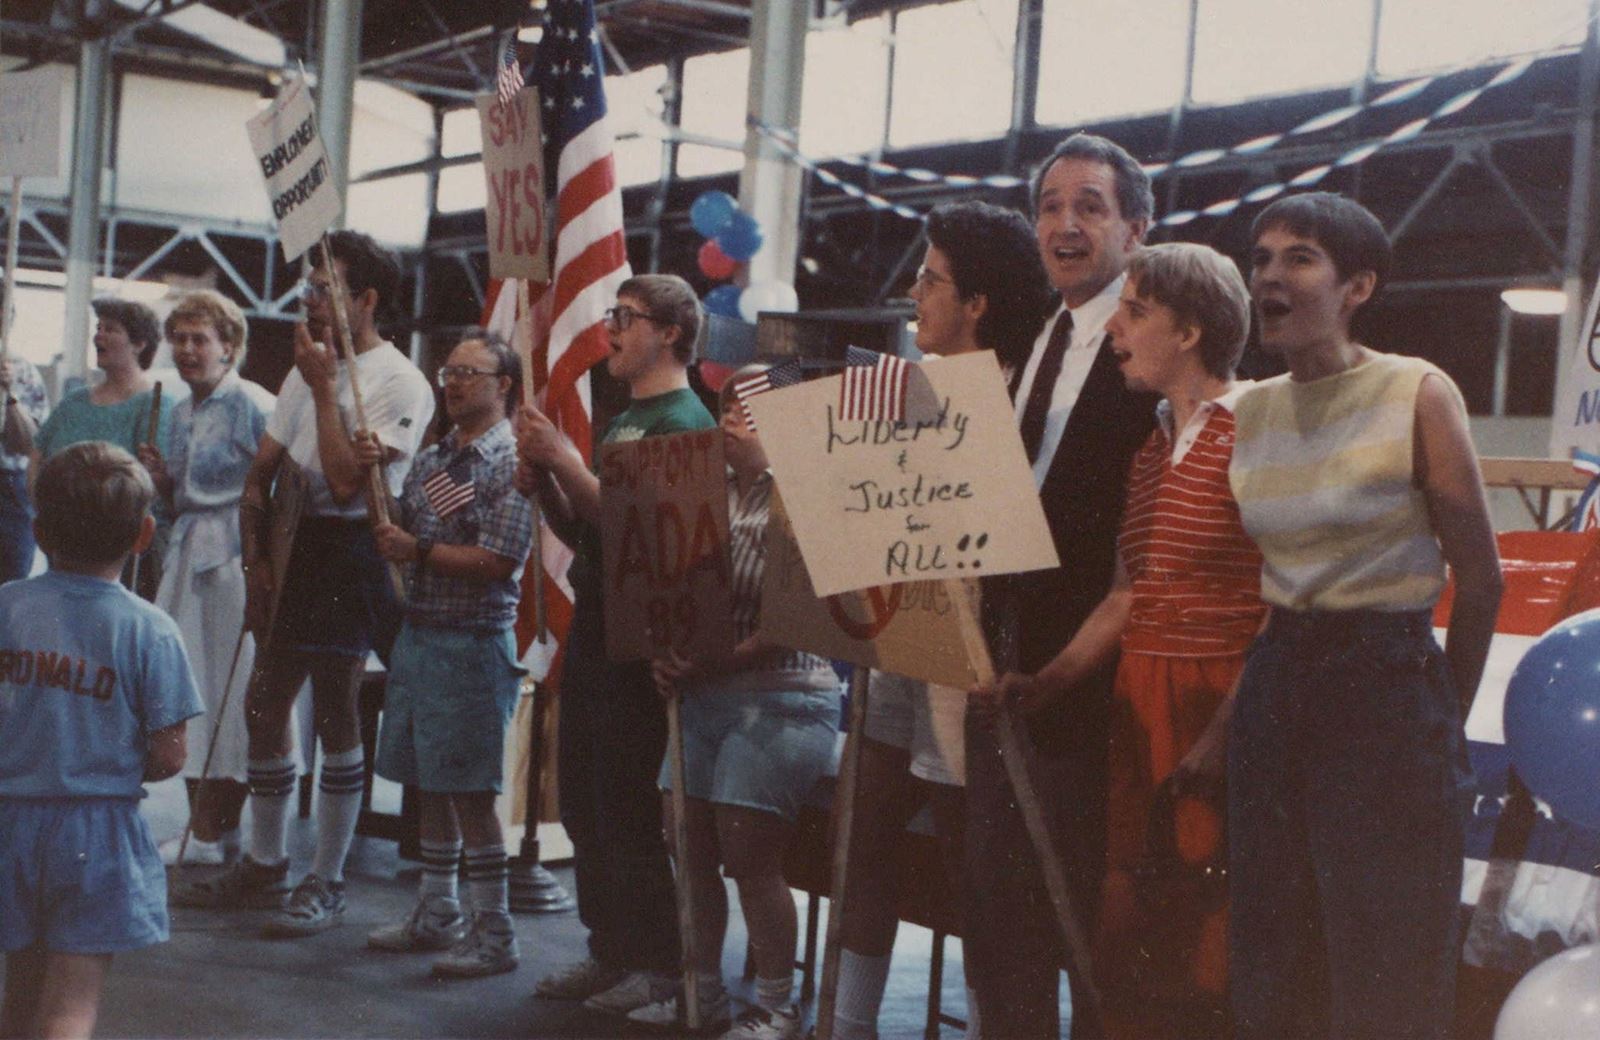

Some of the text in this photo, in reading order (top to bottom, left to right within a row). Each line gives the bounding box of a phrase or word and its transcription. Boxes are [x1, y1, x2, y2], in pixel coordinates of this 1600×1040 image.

[489, 100, 528, 147] SAY
[491, 163, 543, 257] YES
[603, 431, 713, 490] SUPPORT
[614, 500, 728, 592] ADA
[0, 648, 117, 702] RONALD
